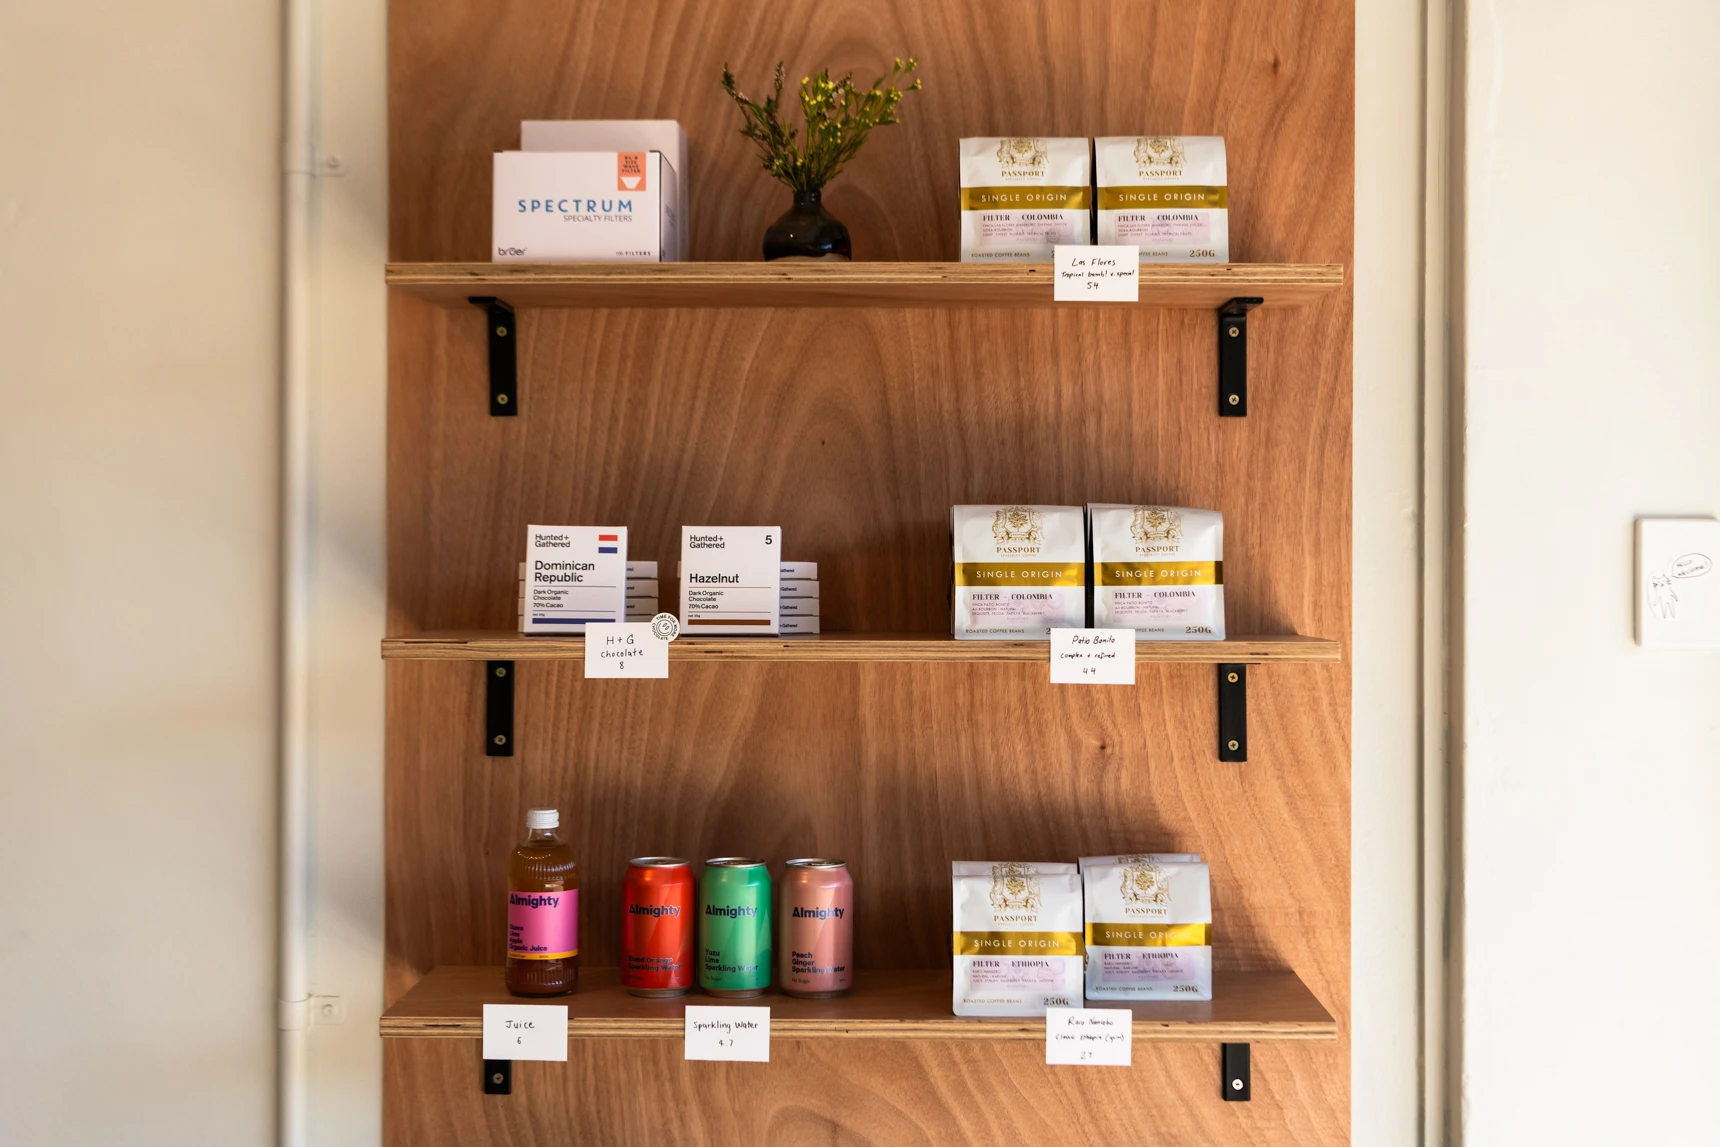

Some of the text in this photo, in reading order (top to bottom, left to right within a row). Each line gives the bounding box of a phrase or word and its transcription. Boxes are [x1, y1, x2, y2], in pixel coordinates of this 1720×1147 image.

[982, 194, 1067, 202] SINGLE ORIGIN
[1119, 193, 1205, 202] SINGLE ORIGIN
[518, 199, 632, 213] SPECTRUM
[1189, 250, 1215, 258] 250G
[1071, 258, 1116, 267] Las Flores
[1087, 281, 1099, 290] 54
[765, 535, 773, 545] 5
[1135, 545, 1180, 553] PASSPORT
[534, 560, 595, 571] Dominican
[534, 572, 584, 584] Republic
[689, 573, 740, 583] Hazelnut
[1115, 569, 1201, 578] SINGLE ORIGIN
[667, 615, 676, 624] FOR
[1185, 626, 1212, 634] 250G
[606, 636, 615, 646] H
[626, 634, 634, 645] G
[1071, 635, 1116, 645] Patio Bonito
[1094, 652, 1116, 660] refined
[619, 661, 625, 670] 8
[1082, 667, 1096, 675] 44
[509, 894, 559, 909] Almighty
[628, 904, 681, 918] Almighty
[705, 904, 758, 919] Almighty
[792, 906, 845, 920] Almighty
[1125, 907, 1168, 915] PASSPORT
[1105, 931, 1190, 939] SINGLE ORIGIN
[973, 939, 1013, 947] SINGLE
[705, 948, 720, 957] Yuzu
[791, 951, 813, 959] Peach
[1142, 952, 1179, 960] ETHIOPIA
[705, 956, 719, 964] Lime
[791, 959, 815, 967] Ginger
[972, 960, 1049, 968] FILTER ETHIOPIA
[628, 963, 681, 972] Sparkling Water
[705, 964, 736, 973] Sparkling
[791, 965, 846, 975] Sparkling Water
[1173, 985, 1198, 993] 250G
[1043, 997, 1069, 1006] 250G
[505, 1020, 535, 1029] Juice
[693, 1020, 759, 1034] Sparkling Water
[517, 1036, 522, 1045] 6
[718, 1039, 734, 1047] 4.7
